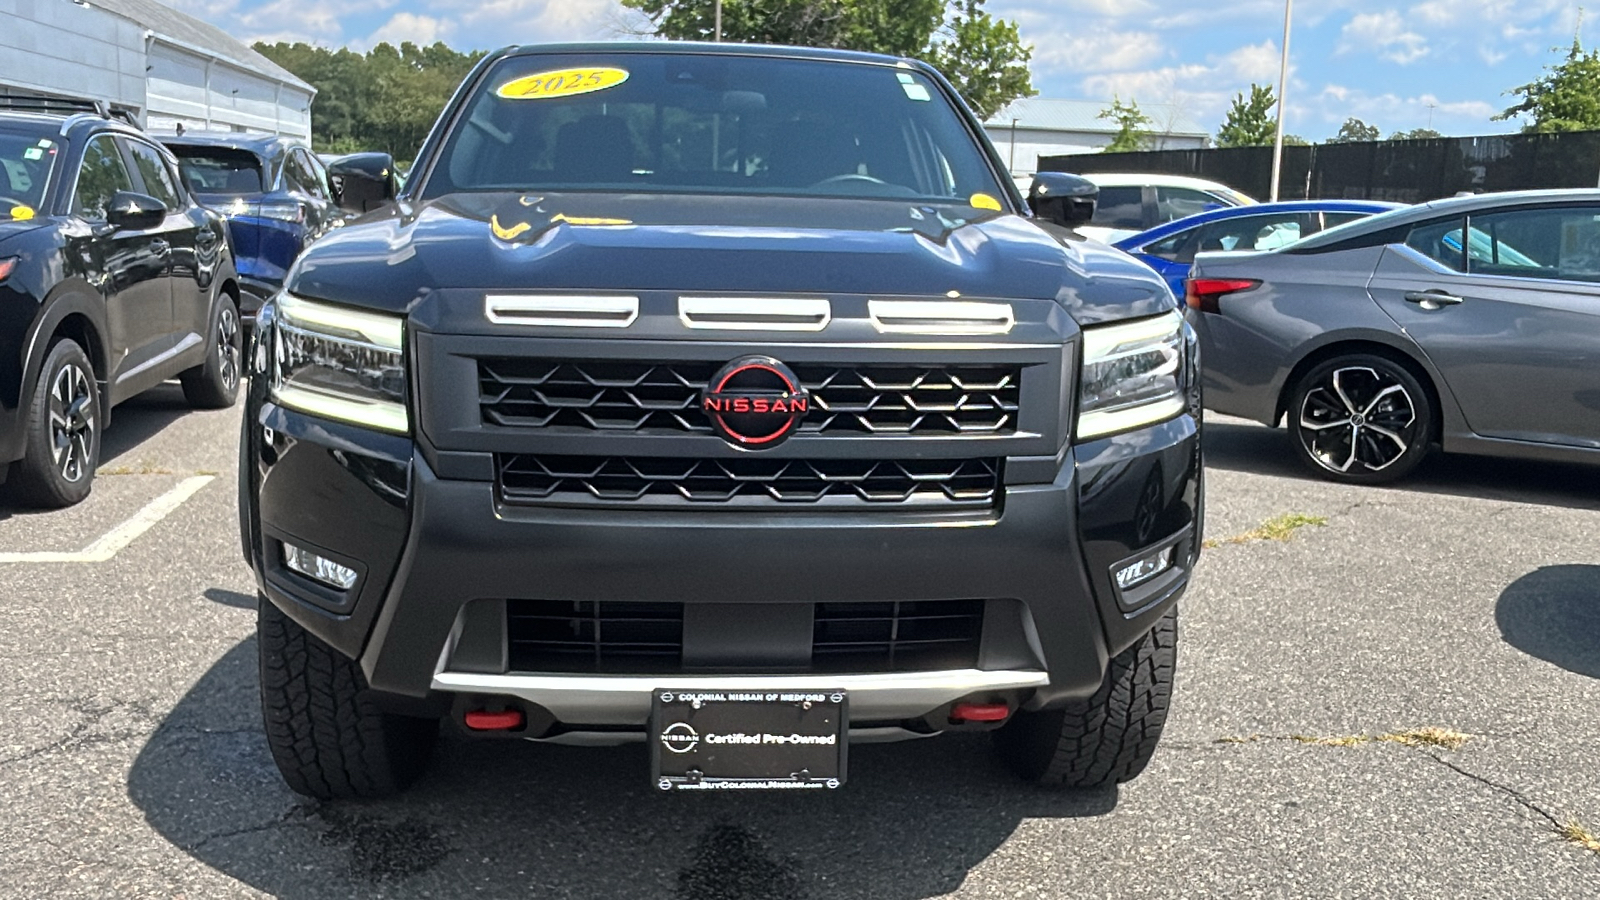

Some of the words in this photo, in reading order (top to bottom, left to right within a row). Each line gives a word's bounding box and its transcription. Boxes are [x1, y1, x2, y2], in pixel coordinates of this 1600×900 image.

[522, 71, 604, 96] 2025
[704, 397, 807, 413] NISSAN
[678, 693, 727, 702] COLONIAL
[728, 693, 764, 702] NISSAN
[765, 693, 779, 702] OF
[780, 693, 826, 702] MEDFORD
[660, 734, 700, 742] NISSAN
[705, 733, 761, 744] Certified
[762, 733, 836, 745] Pre-Owned
